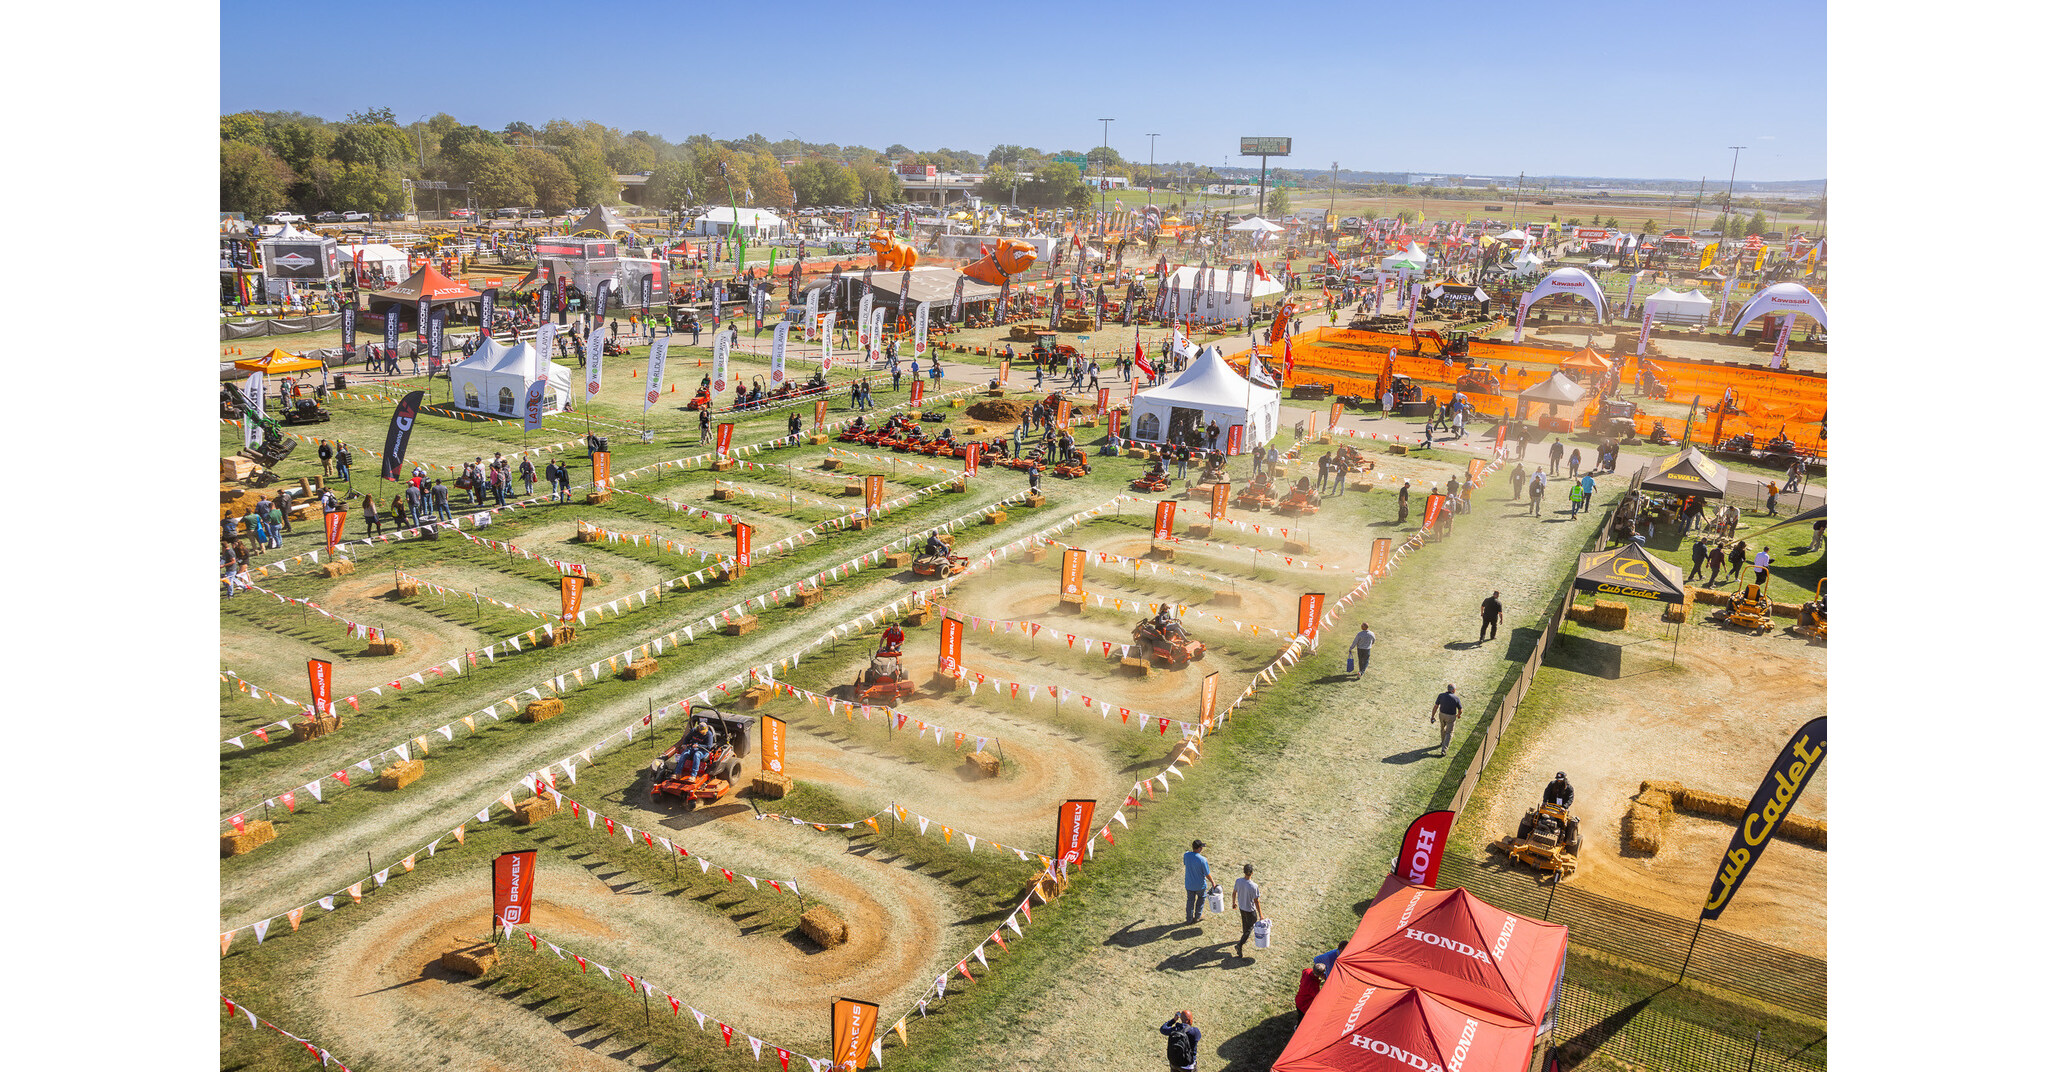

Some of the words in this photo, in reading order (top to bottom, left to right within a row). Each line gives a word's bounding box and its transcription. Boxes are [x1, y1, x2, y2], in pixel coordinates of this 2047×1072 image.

[391, 287, 415, 296] ALTOZ
[433, 288, 465, 296] ALTOZ
[597, 284, 606, 315] ENCORE
[1444, 293, 1475, 301] FINISH
[1771, 296, 1810, 305] Kawasaki
[1408, 294, 1416, 323] Kawasaki
[1515, 303, 1526, 333] Kawasaki
[1369, 334, 1401, 345] Kubota
[1638, 313, 1651, 344] Kawasaki
[1774, 325, 1789, 357] Kawasaki
[590, 335, 600, 386] WORLDLAWN
[776, 327, 785, 367] WORLDLAWN
[1319, 354, 1356, 367] Kubota
[652, 344, 664, 388] WORLDLAWN
[1370, 359, 1408, 374] Kota
[1735, 370, 1777, 383] Kubota
[1756, 384, 1801, 398] Kubota
[529, 390, 540, 425] LASTEC
[392, 431, 403, 458] EQUIPMENT
[1667, 473, 1701, 483] DeWALT
[1162, 502, 1170, 529] GRAVELY
[1071, 551, 1079, 582] ARIENS
[1377, 540, 1385, 570] ARIENS
[567, 579, 576, 610] ARIENS
[1597, 583, 1622, 595] Cub
[1621, 586, 1660, 600] Cadet
[1625, 578, 1654, 586] SERIES
[1306, 595, 1316, 628] GRAVELY
[948, 621, 956, 655] GRAVELY
[1072, 803, 1082, 848] GRAVELY
[1704, 847, 1751, 910] Cub
[1744, 734, 1823, 847] Cadet
[510, 855, 520, 902] GRAVELY
[1396, 889, 1425, 931] HONDA
[1404, 928, 1491, 965] HONDA
[1492, 915, 1517, 962] HONDA
[1341, 986, 1377, 1037] HONDA
[849, 1005, 861, 1059] ARIENS
[1448, 1017, 1479, 1072] HONDA
[1349, 1033, 1448, 1072] HONDA
